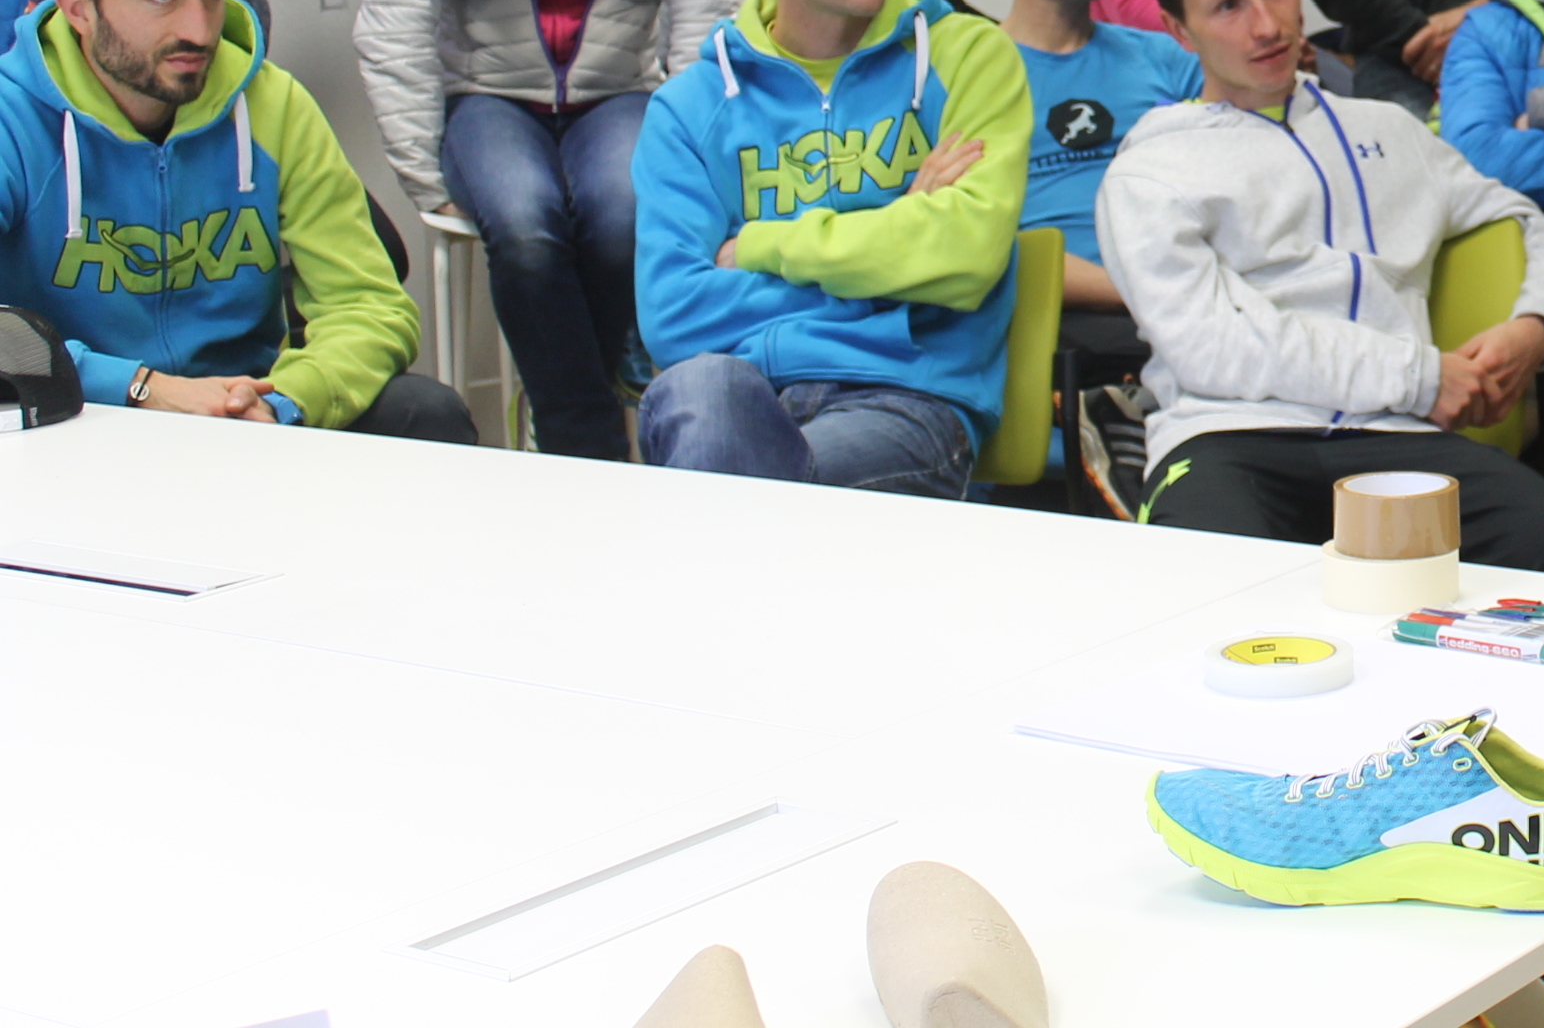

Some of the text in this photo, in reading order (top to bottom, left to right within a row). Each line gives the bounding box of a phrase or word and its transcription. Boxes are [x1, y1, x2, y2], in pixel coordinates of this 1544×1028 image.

[738, 110, 935, 222] HOKA
[52, 206, 278, 295] HOKA
[1448, 638, 1490, 655] edding
